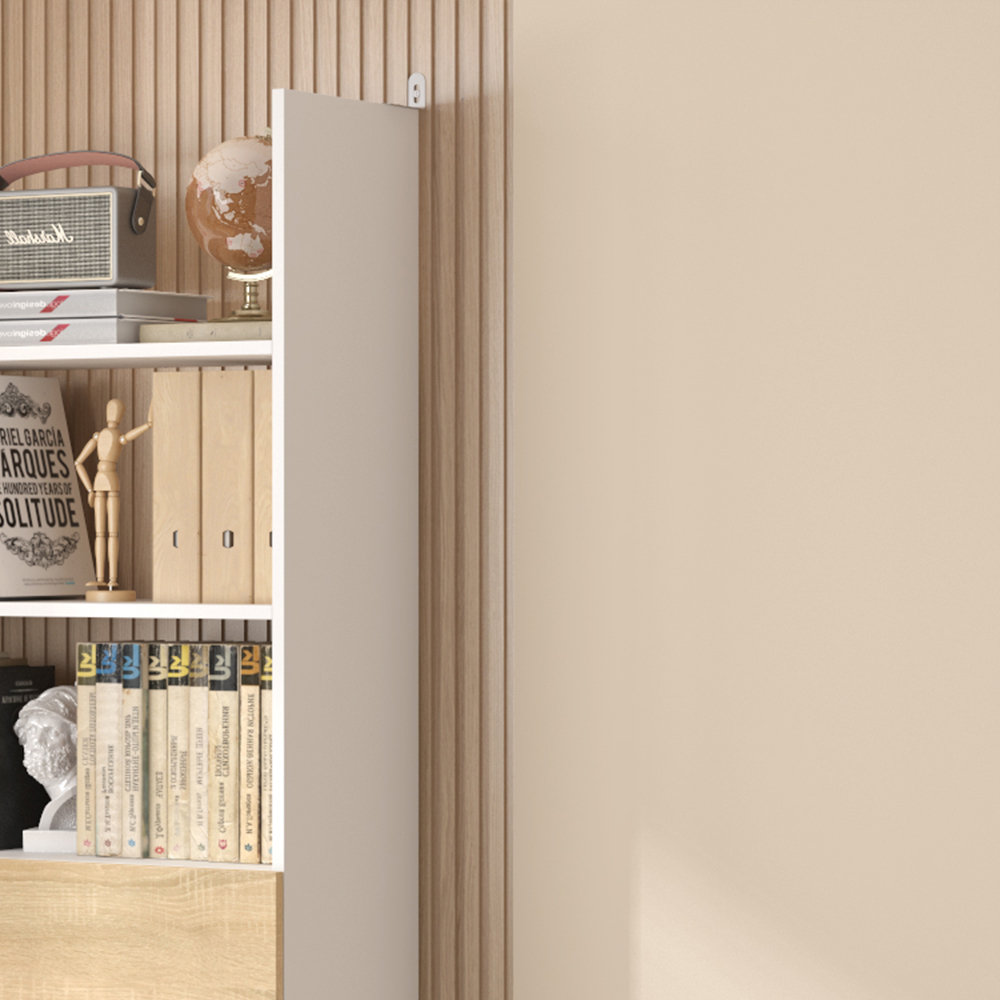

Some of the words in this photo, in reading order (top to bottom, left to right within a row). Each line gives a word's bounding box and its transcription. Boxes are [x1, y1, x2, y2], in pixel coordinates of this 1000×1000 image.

[24, 426, 65, 447] GARCÍA
[2, 482, 38, 496] HUNDRED
[38, 483, 64, 496] YEARS
[63, 483, 72, 495] OF
